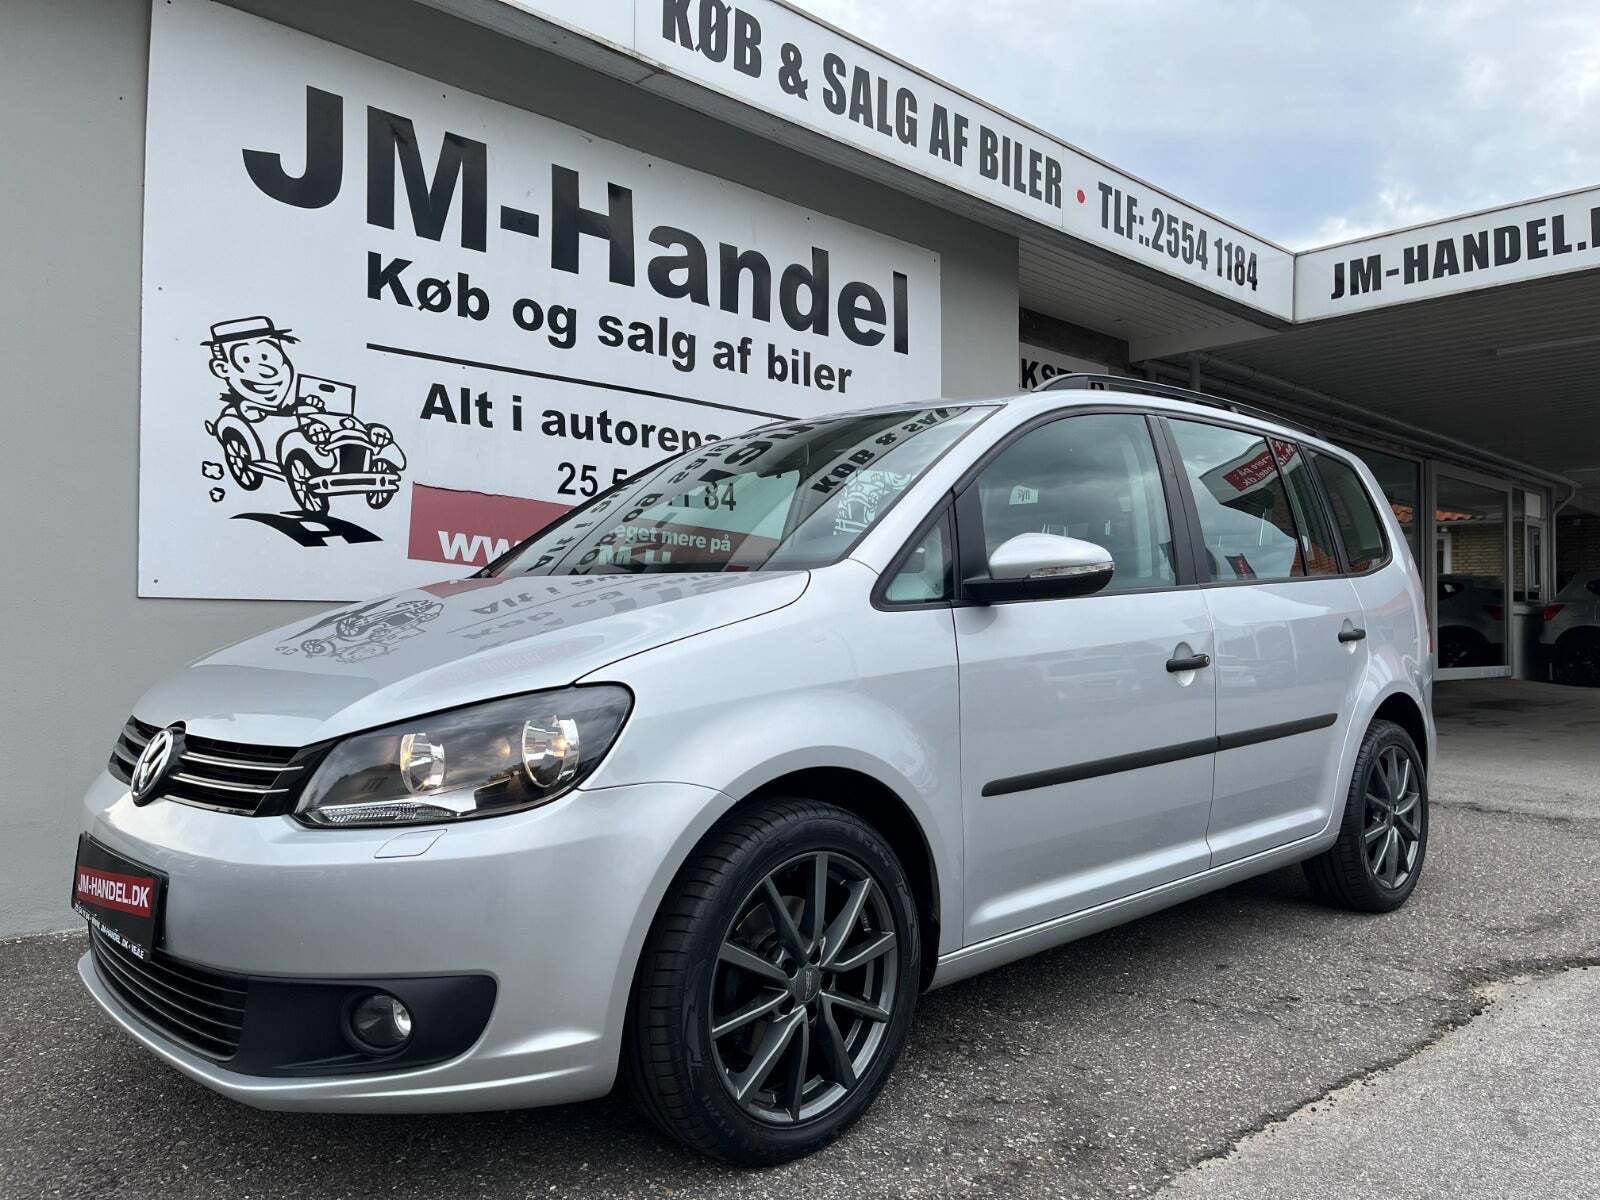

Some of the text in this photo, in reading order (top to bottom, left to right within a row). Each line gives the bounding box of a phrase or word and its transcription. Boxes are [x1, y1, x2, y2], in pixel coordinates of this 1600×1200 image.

[662, 0, 763, 79] KØB
[779, 42, 809, 101] &
[822, 53, 918, 149] SALG
[929, 103, 969, 167] AF
[979, 123, 1062, 209] BILER
[1214, 236, 1258, 292] 1184
[242, 84, 910, 355] JM-Handel
[366, 252, 853, 394] Køb og salg af biler
[420, 383, 494, 428] Alt
[512, 394, 522, 431] i
[557, 462, 599, 497] 25
[608, 522, 731, 553] eget mere på
[77, 873, 150, 909] JM-HANDEL.DK
